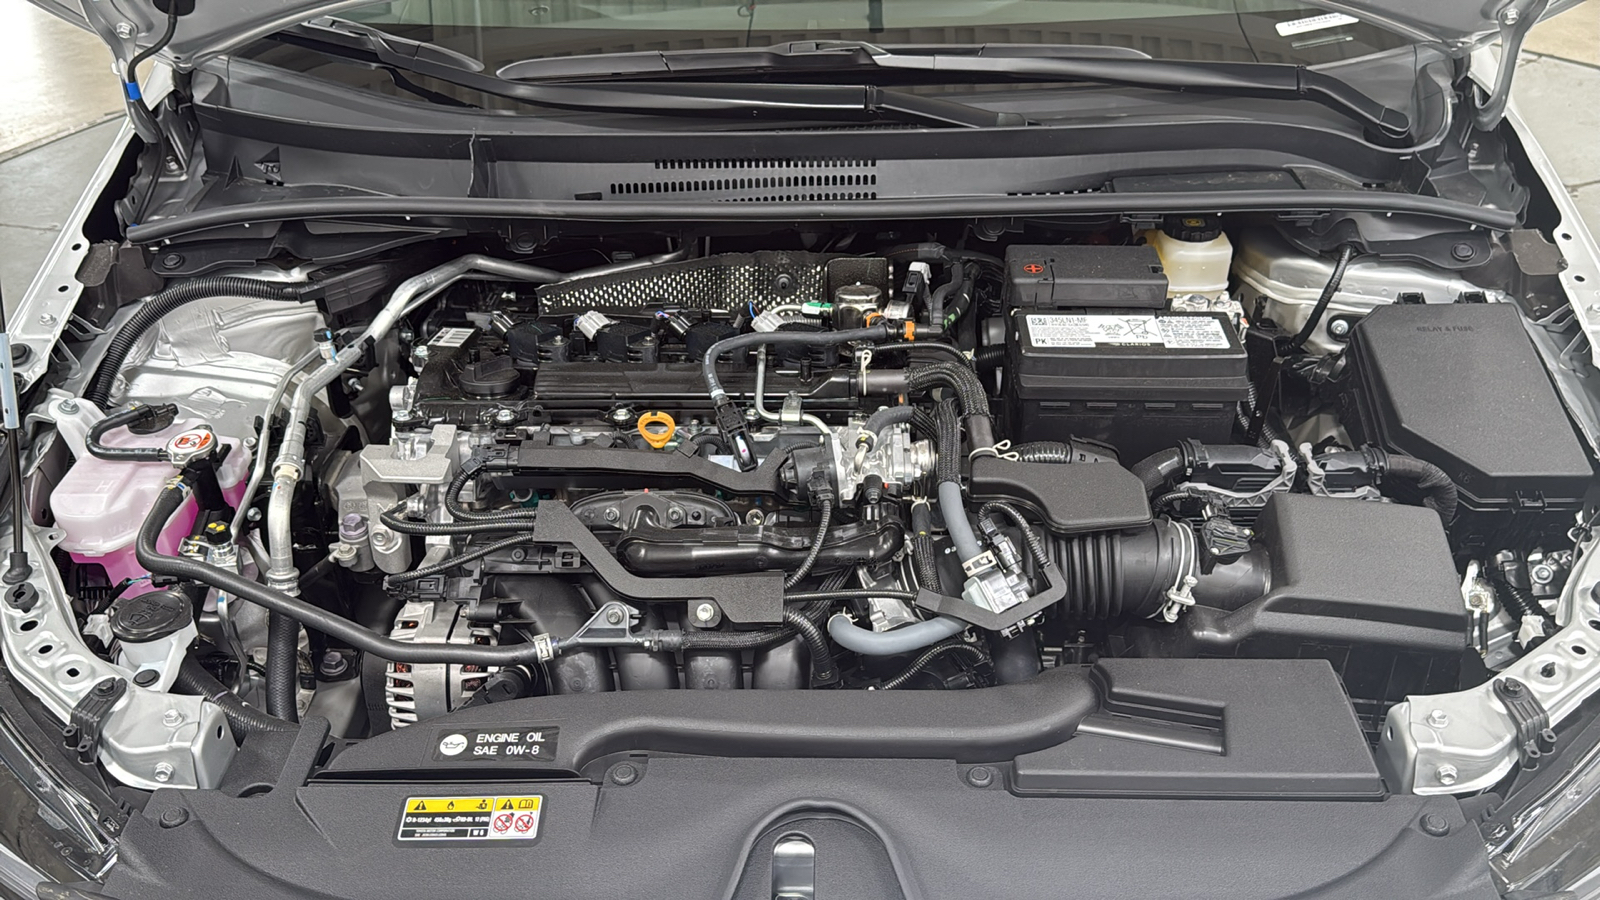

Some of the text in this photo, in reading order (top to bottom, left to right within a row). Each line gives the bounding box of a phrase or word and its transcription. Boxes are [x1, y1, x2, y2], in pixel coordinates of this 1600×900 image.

[476, 732, 545, 743] ENGINE OIL
[473, 745, 540, 755] SAE 0W-8
